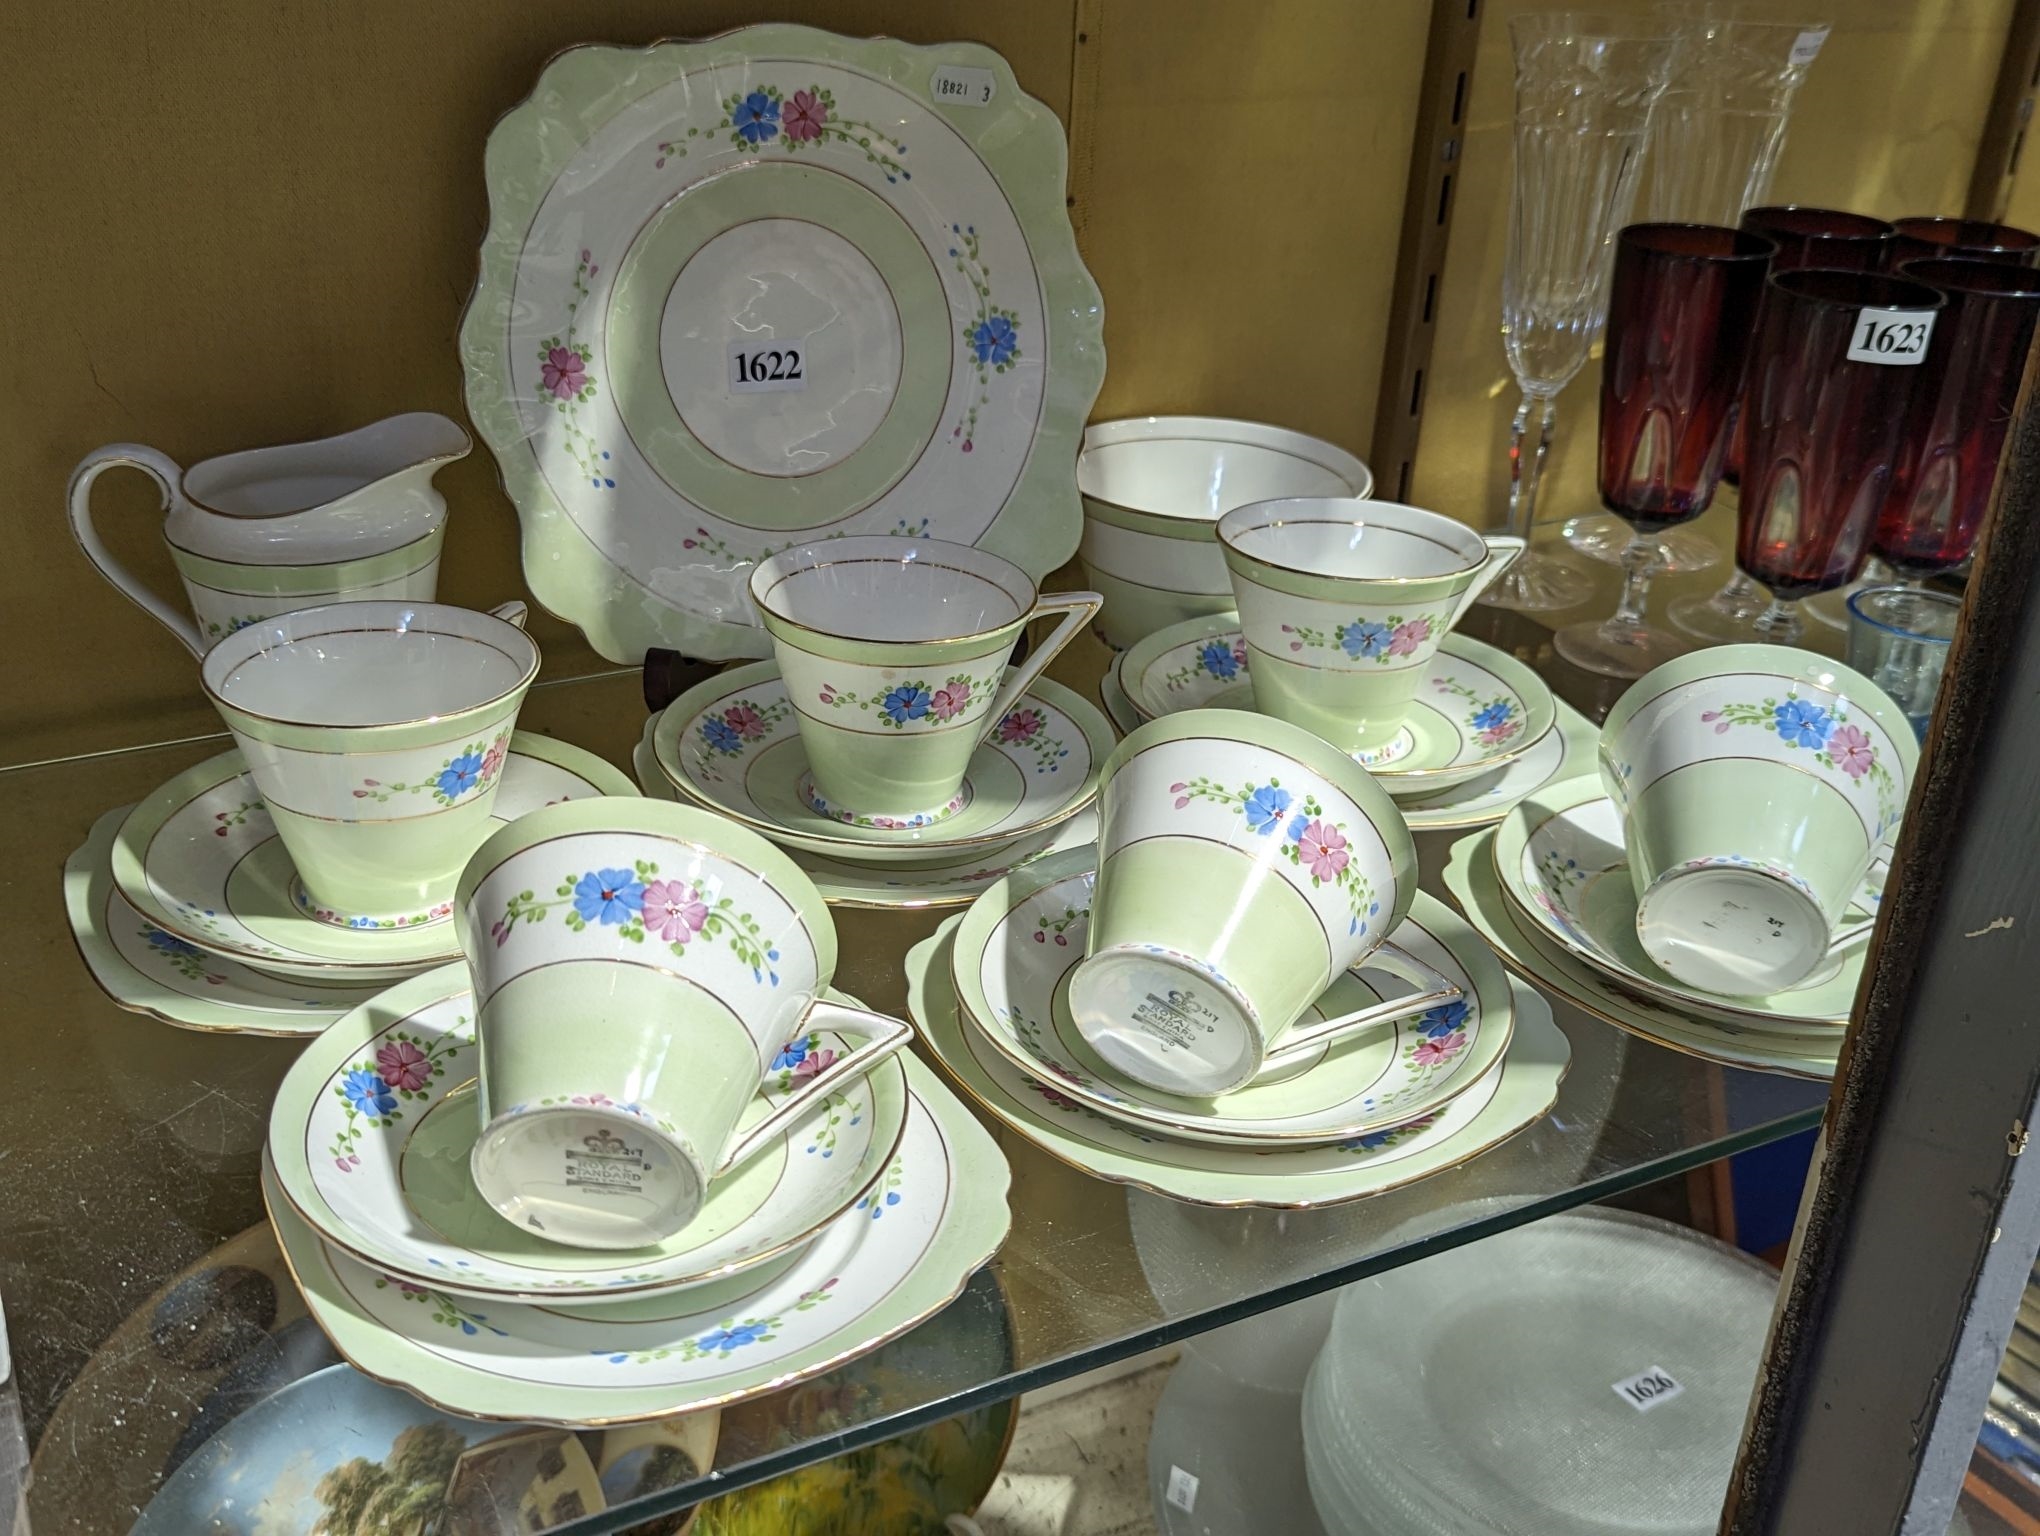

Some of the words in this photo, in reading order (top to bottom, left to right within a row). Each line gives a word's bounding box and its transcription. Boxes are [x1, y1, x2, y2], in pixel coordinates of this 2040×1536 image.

[937, 79, 968, 96] 18821
[982, 86, 990, 102] 3
[1857, 321, 1926, 354] 1623
[735, 350, 802, 382] 1622
[1137, 1004, 1196, 1041] STANDARD
[1151, 1003, 1192, 1032] ROYAL
[565, 1165, 641, 1181] STANDARD
[577, 1160, 633, 1173] ROYAL
[1625, 1373, 1674, 1403] 1626
